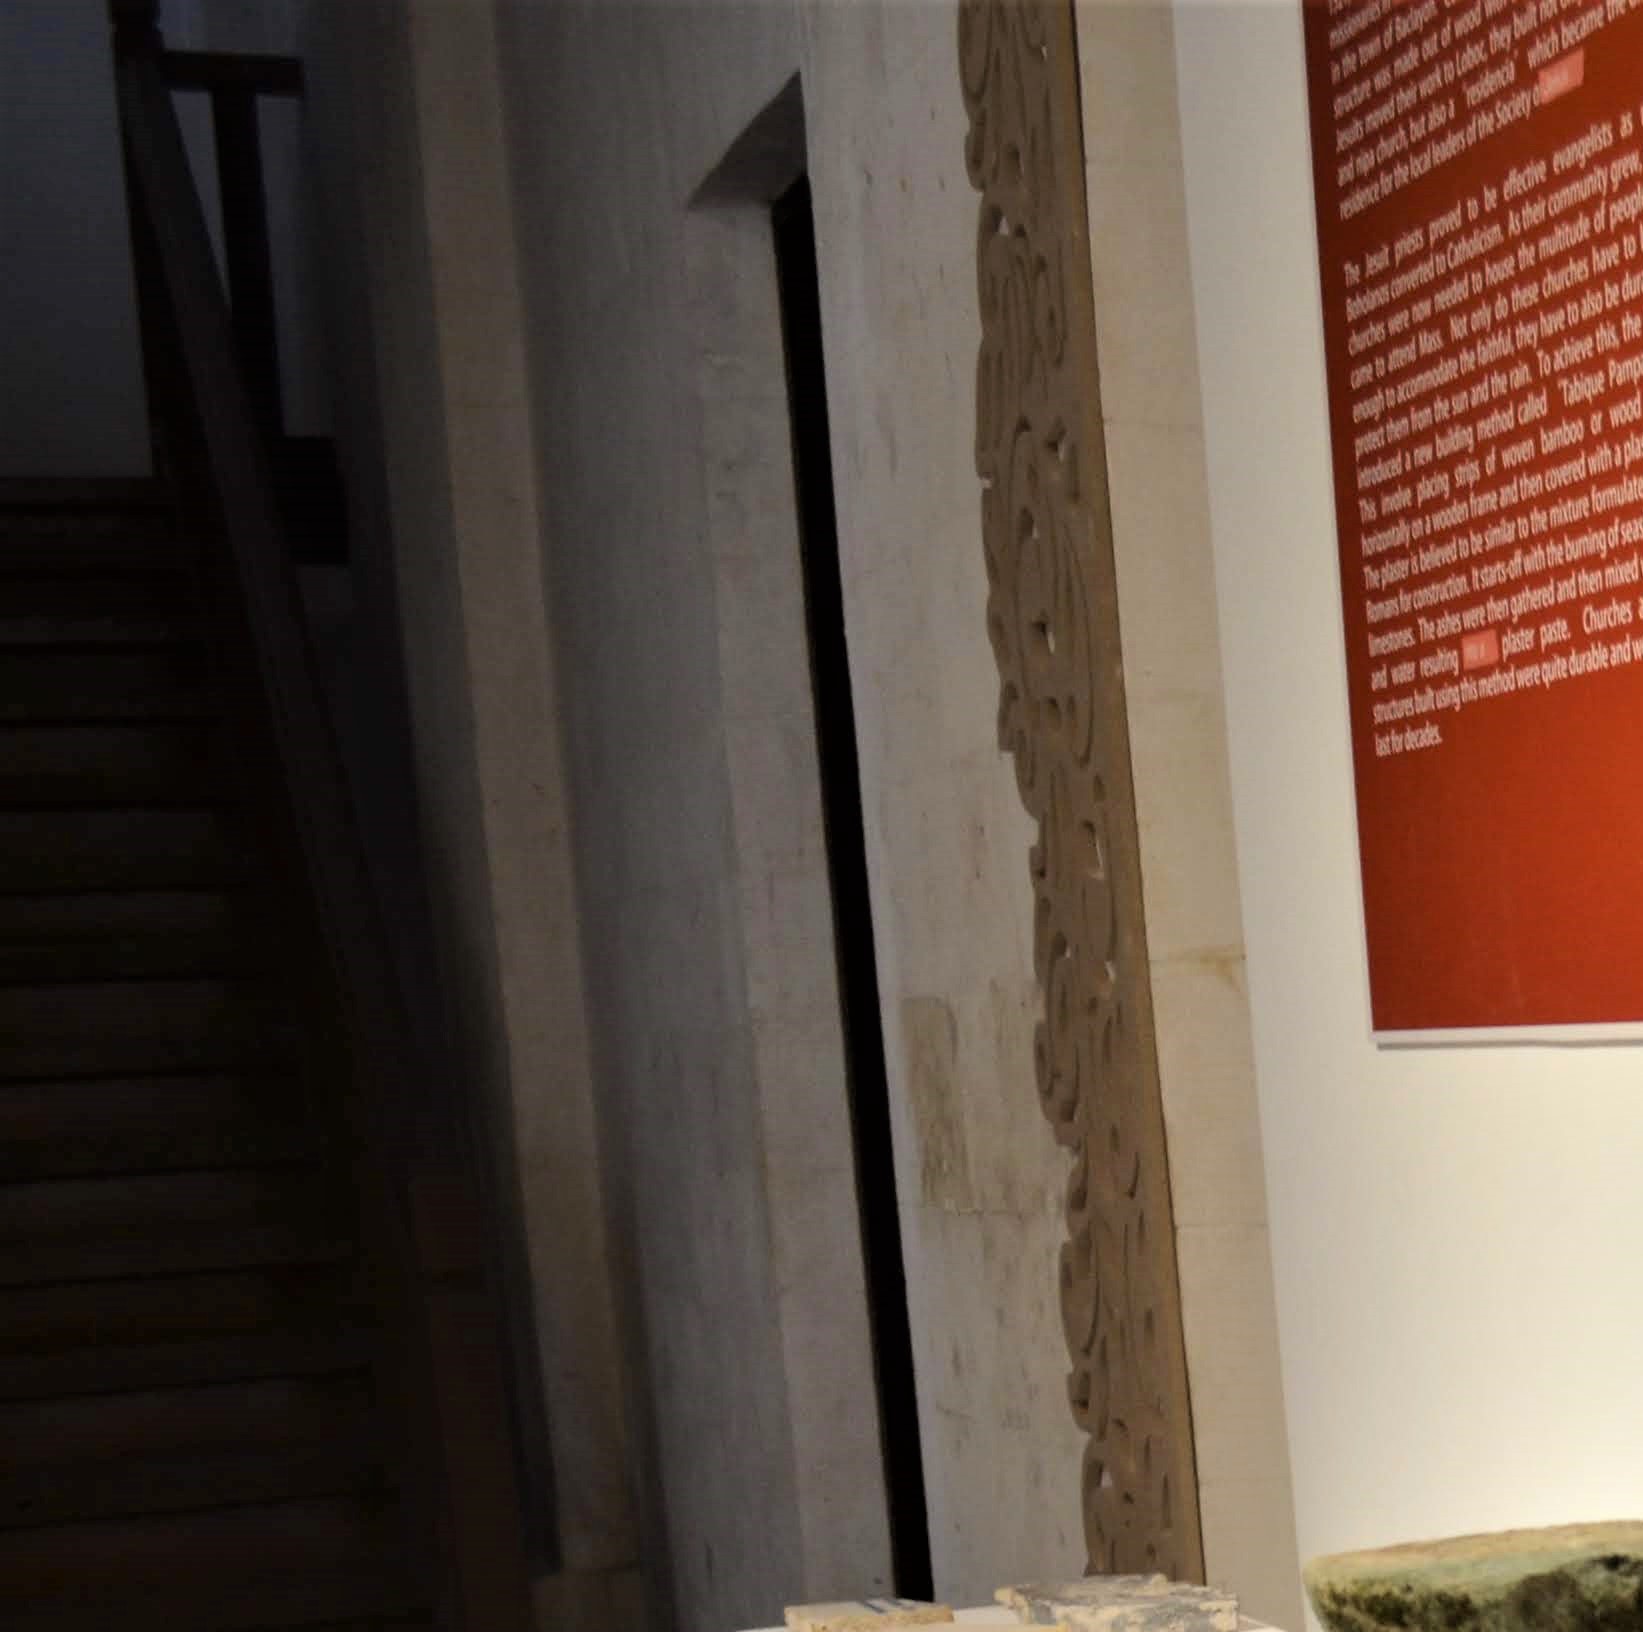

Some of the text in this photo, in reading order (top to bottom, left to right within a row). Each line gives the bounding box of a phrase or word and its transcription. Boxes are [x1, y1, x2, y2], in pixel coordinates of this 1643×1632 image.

[1503, 160, 1547, 201] effective
[1553, 123, 1613, 174] evangelists
[1620, 112, 1633, 138] as
[1521, 196, 1545, 230] their
[1547, 166, 1608, 216] community
[1610, 151, 1643, 192] grew,
[1539, 212, 1590, 260] multitude
[1593, 200, 1605, 233] of
[1542, 257, 1589, 298] churches
[1592, 242, 1619, 274] have
[1623, 234, 1637, 260] to
[1540, 308, 1565, 337] have
[1566, 302, 1579, 326] to
[1581, 290, 1603, 320] also
[1604, 281, 1620, 308] be
[1553, 335, 1593, 371] achieve
[1595, 322, 1620, 353] this,
[1622, 311, 1642, 342] the
[1540, 419, 1584, 454] bamboo
[1590, 411, 1602, 435] or
[1609, 389, 1642, 428] wood
[1519, 472, 1543, 501] then
[1545, 451, 1586, 492] covered
[1587, 442, 1613, 475] with
[1614, 445, 1622, 466] a
[1530, 507, 1548, 534] the
[1549, 496, 1589, 527] mixture
[1564, 528, 1607, 562] burning
[1607, 517, 1619, 549] of
[1557, 571, 1577, 603] and
[1578, 568, 1603, 597] then
[1604, 552, 1639, 588] mixed
[1540, 618, 1571, 652] paste.
[1582, 598, 1633, 634] Churches
[1541, 655, 1568, 688] quite
[1568, 642, 1609, 676] durable
[1610, 634, 1631, 666] and
